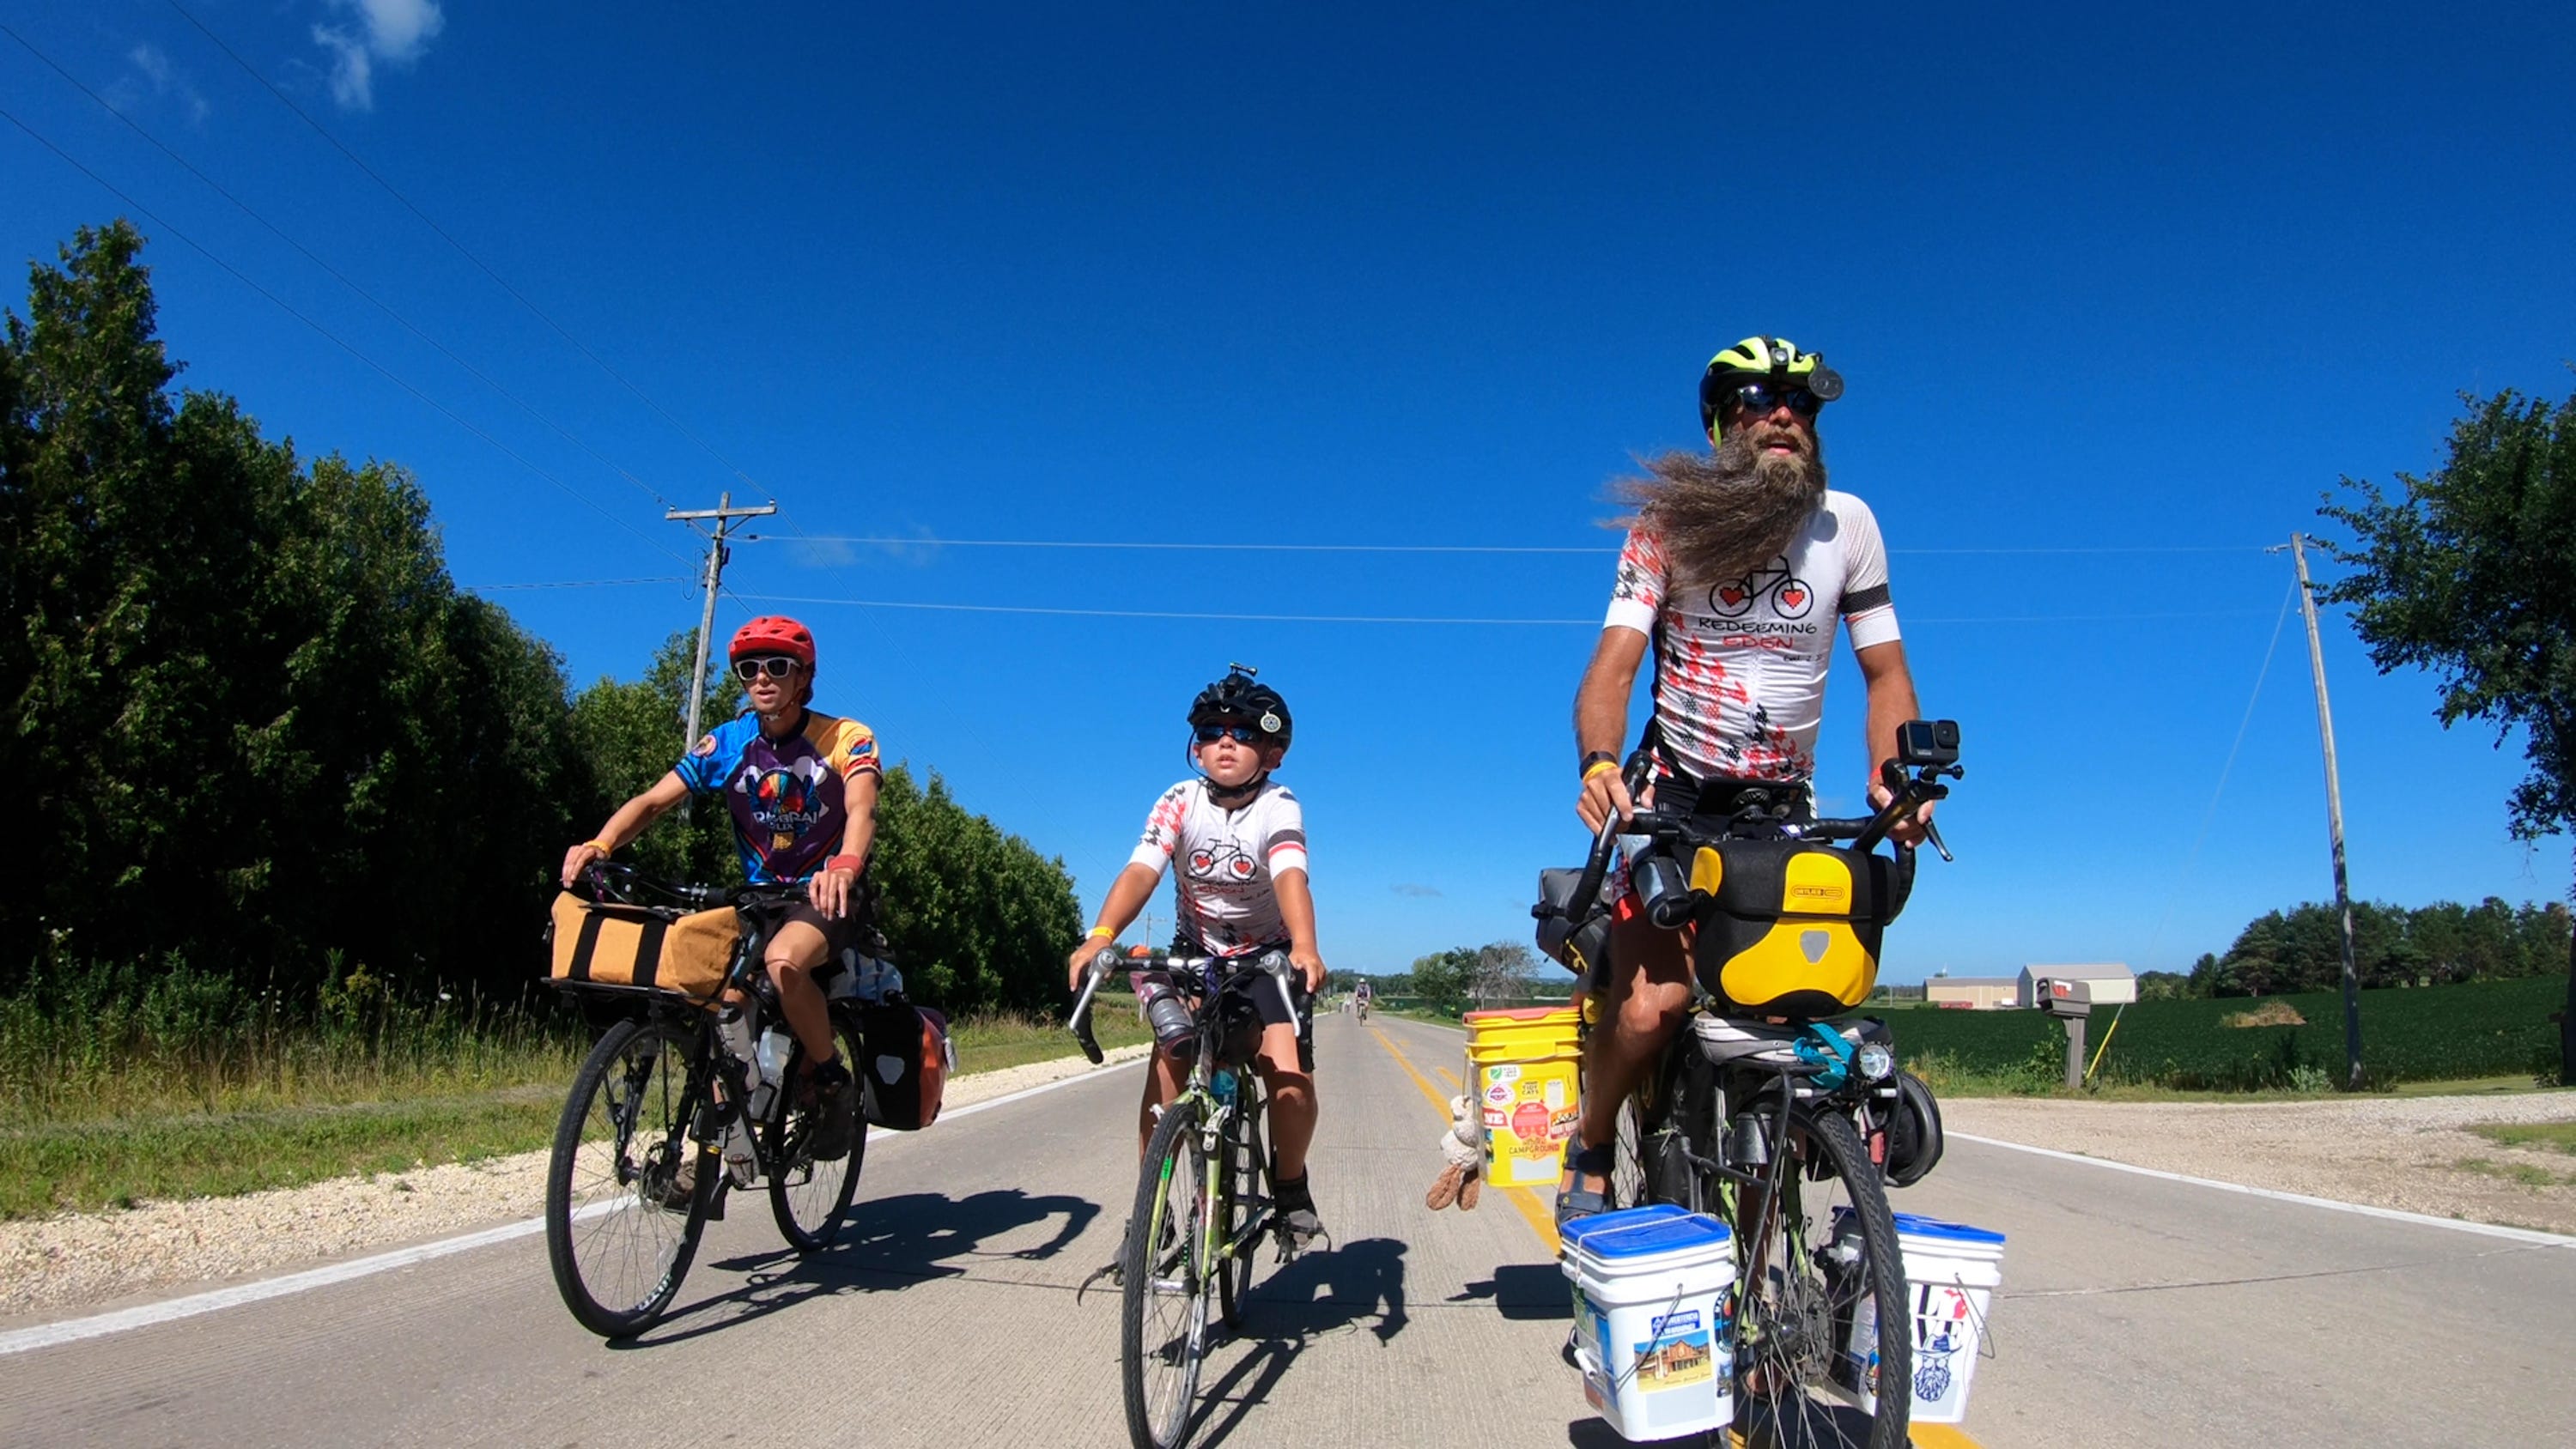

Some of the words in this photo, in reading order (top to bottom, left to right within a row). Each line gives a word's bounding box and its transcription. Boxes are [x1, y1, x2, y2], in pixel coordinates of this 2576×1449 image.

[1698, 617, 1818, 634] REDEEMING
[1723, 635, 1793, 649] EDEN
[1509, 1143, 1560, 1155] CAMPGROUND
